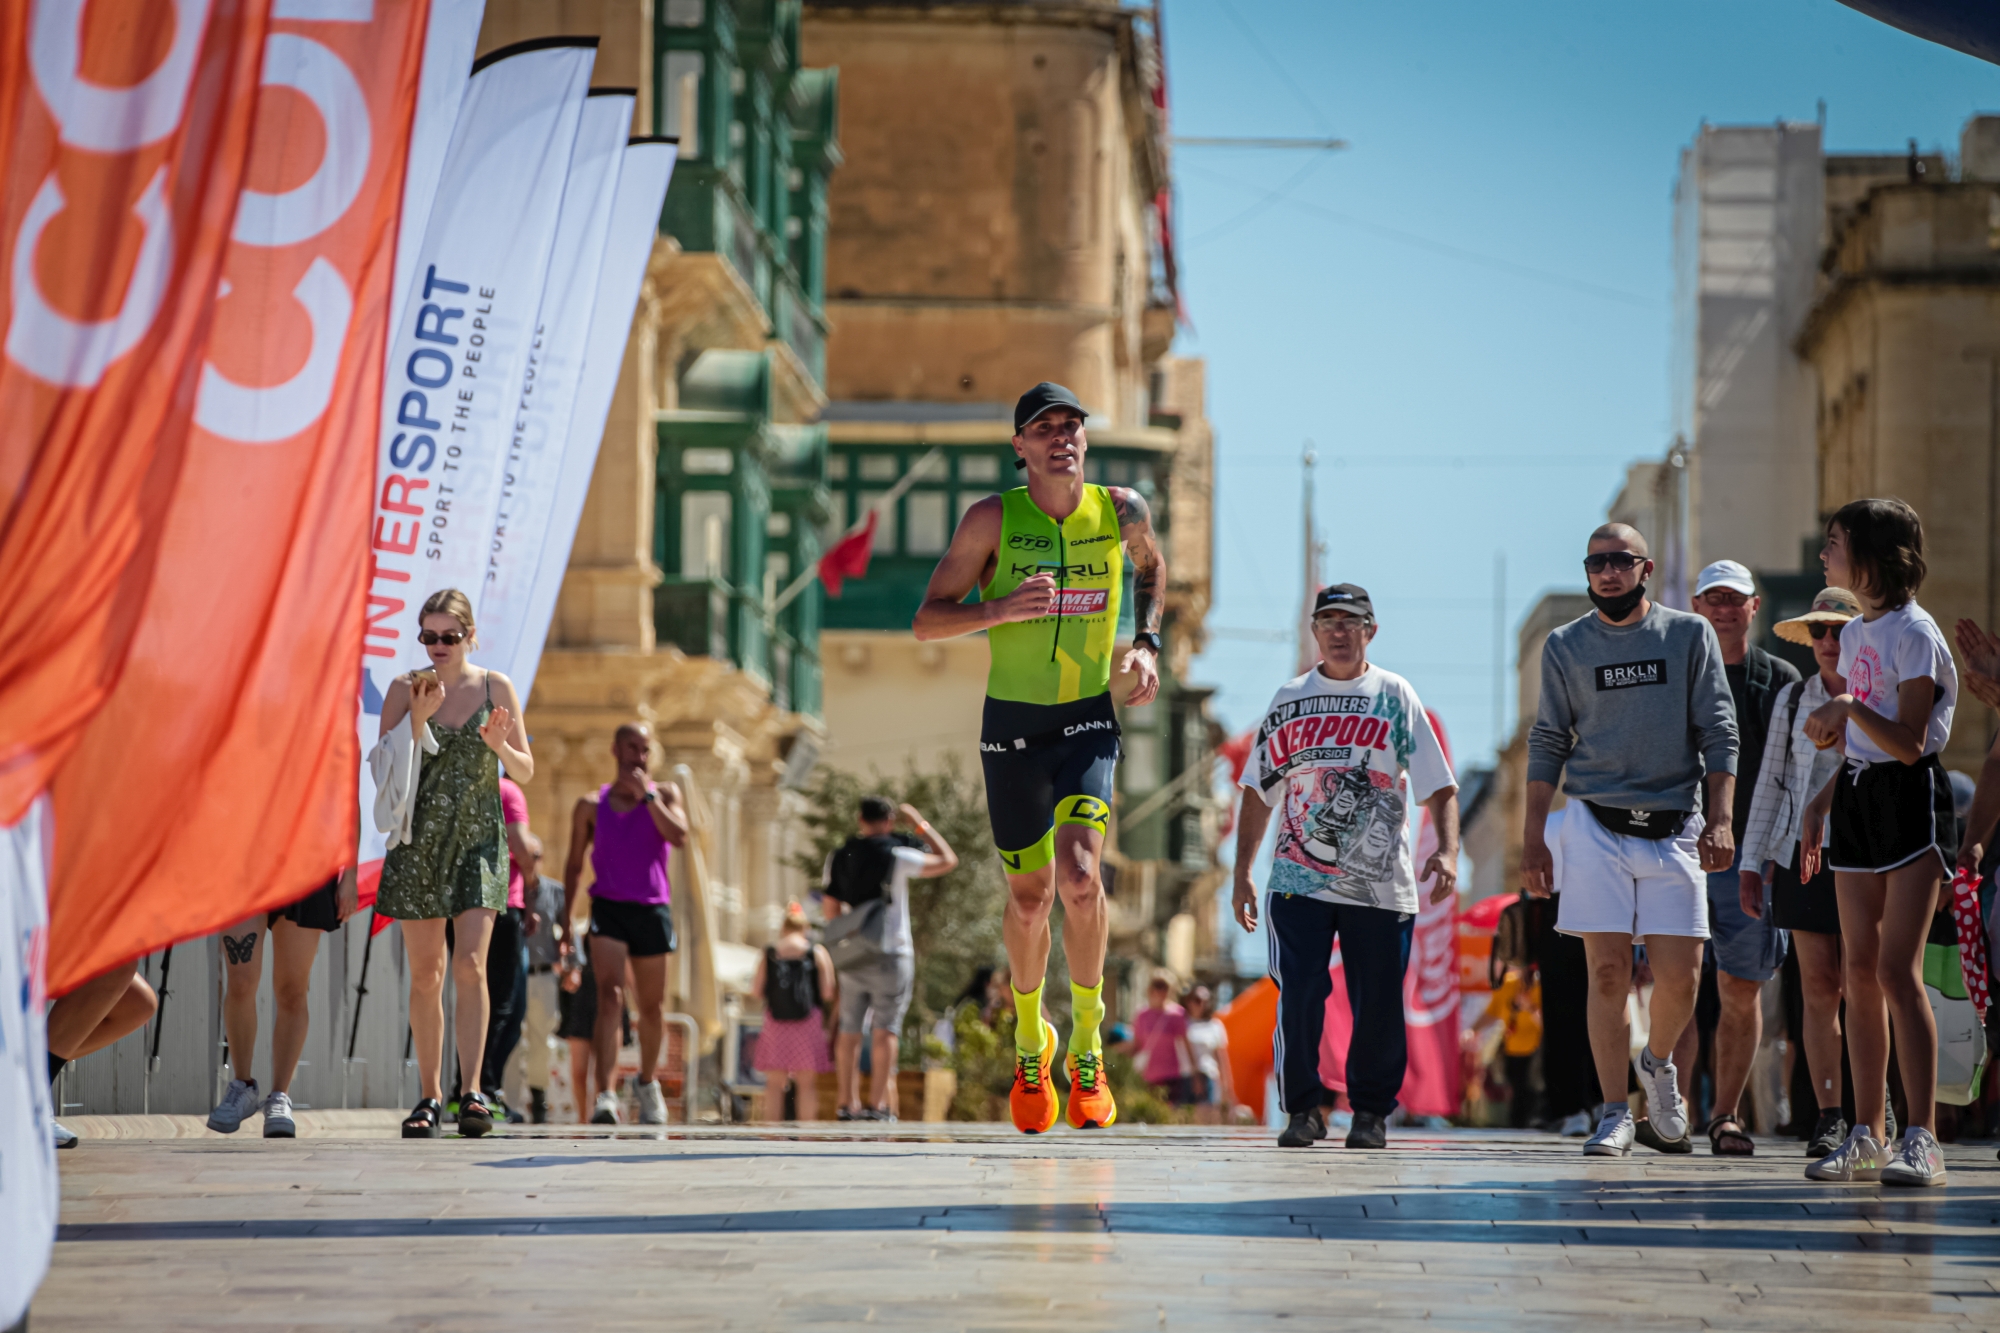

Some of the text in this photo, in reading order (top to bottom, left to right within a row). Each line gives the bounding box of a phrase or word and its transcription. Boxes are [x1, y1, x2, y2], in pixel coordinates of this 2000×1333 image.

[427, 286, 495, 560] SPORT TO THE PEOPLE
[363, 264, 470, 659] INTERSPORT
[1009, 535, 1050, 548] PTO
[1070, 533, 1114, 546] CANNIBAL
[1010, 561, 1109, 578] KORU
[1079, 616, 1106, 624] FUELS
[1604, 663, 1657, 680] BRKLN
[1299, 697, 1369, 716] WINNERS
